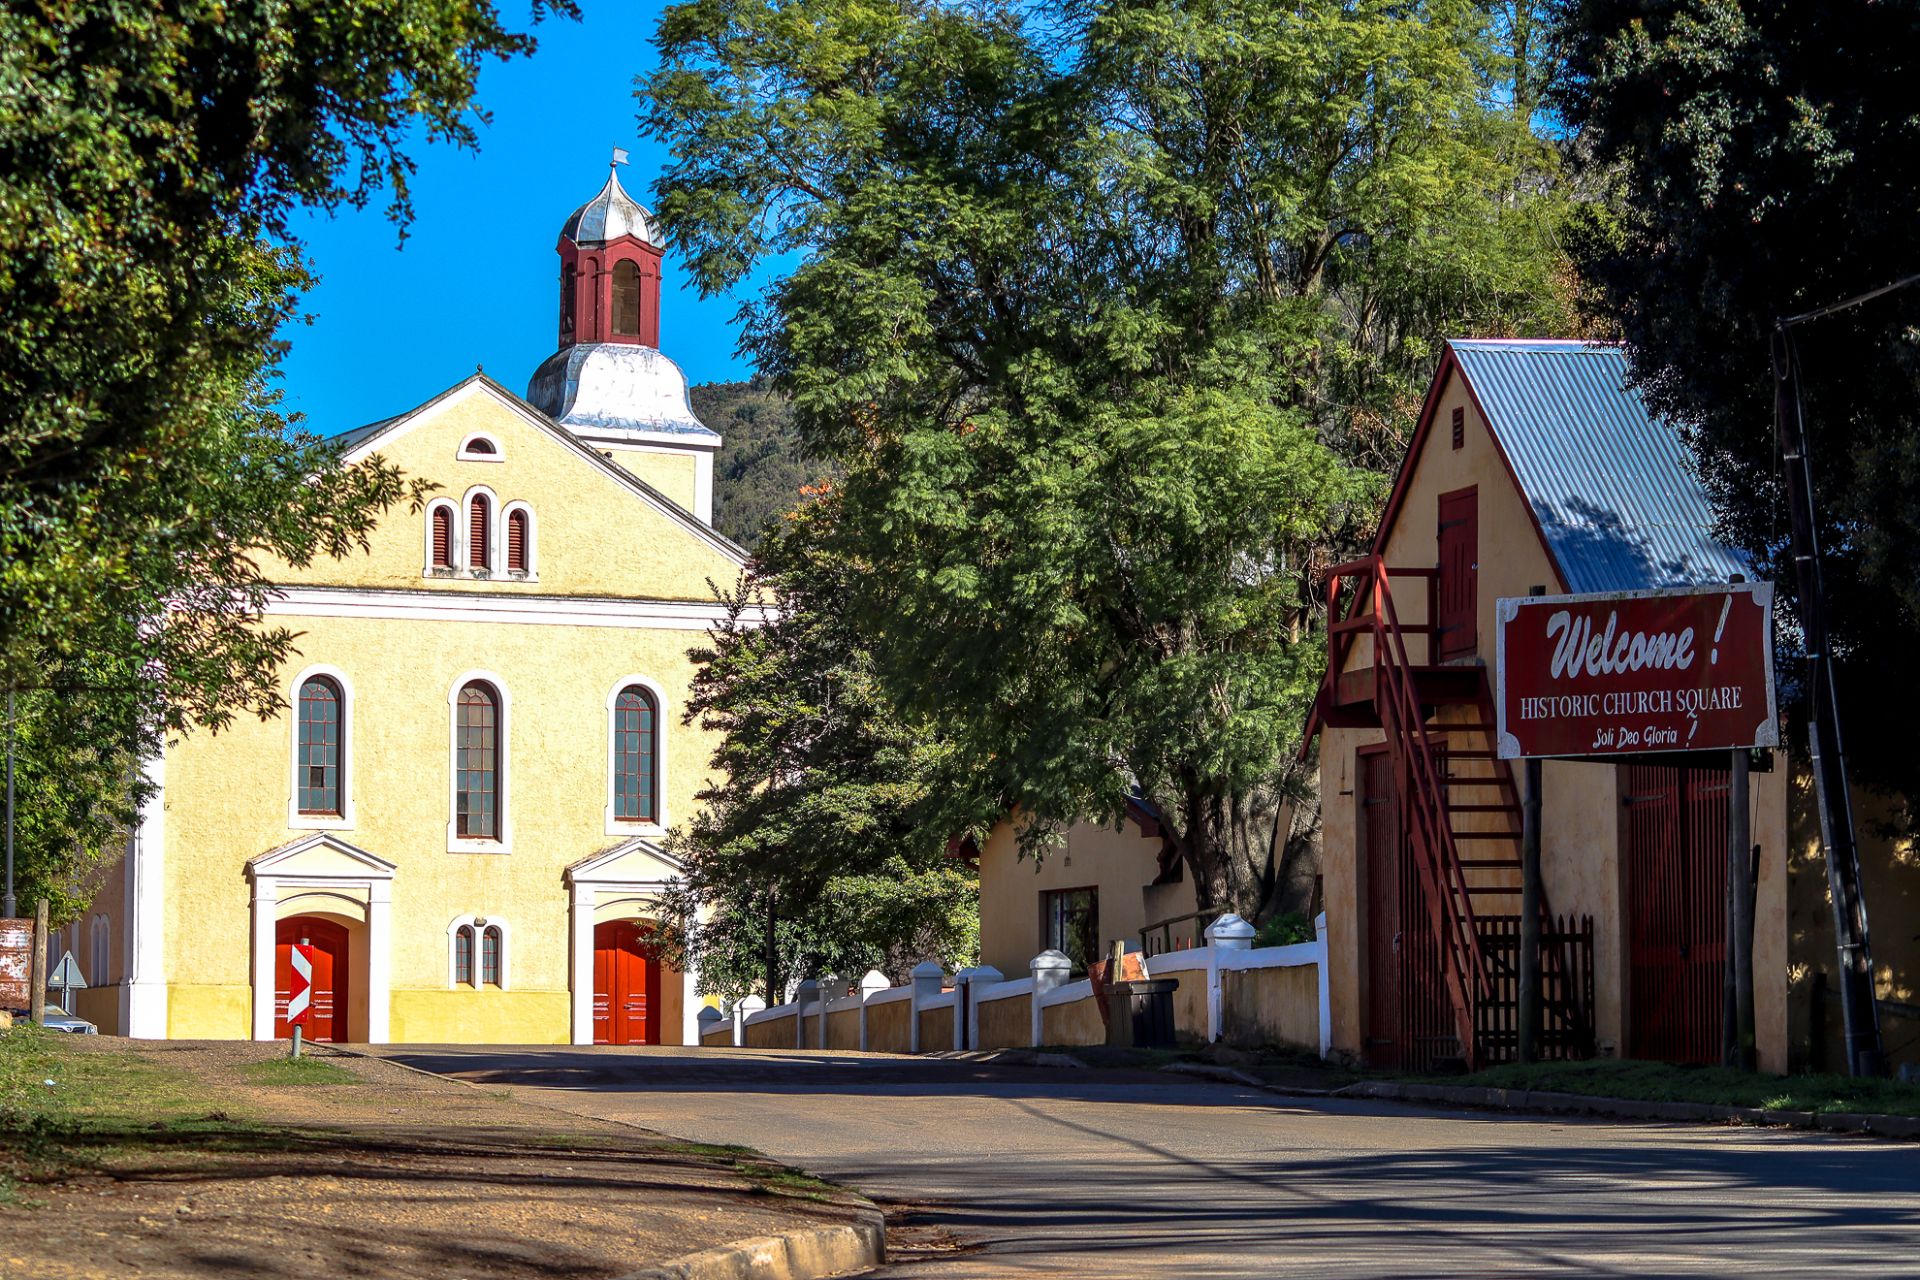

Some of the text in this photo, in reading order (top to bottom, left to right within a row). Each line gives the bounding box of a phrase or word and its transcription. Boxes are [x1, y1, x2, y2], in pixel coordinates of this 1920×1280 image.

[1520, 686, 1743, 719] HISTORIC CHURCH SQUARE
[1592, 727, 1614, 749] Soli
[1616, 726, 1640, 749] Deo
